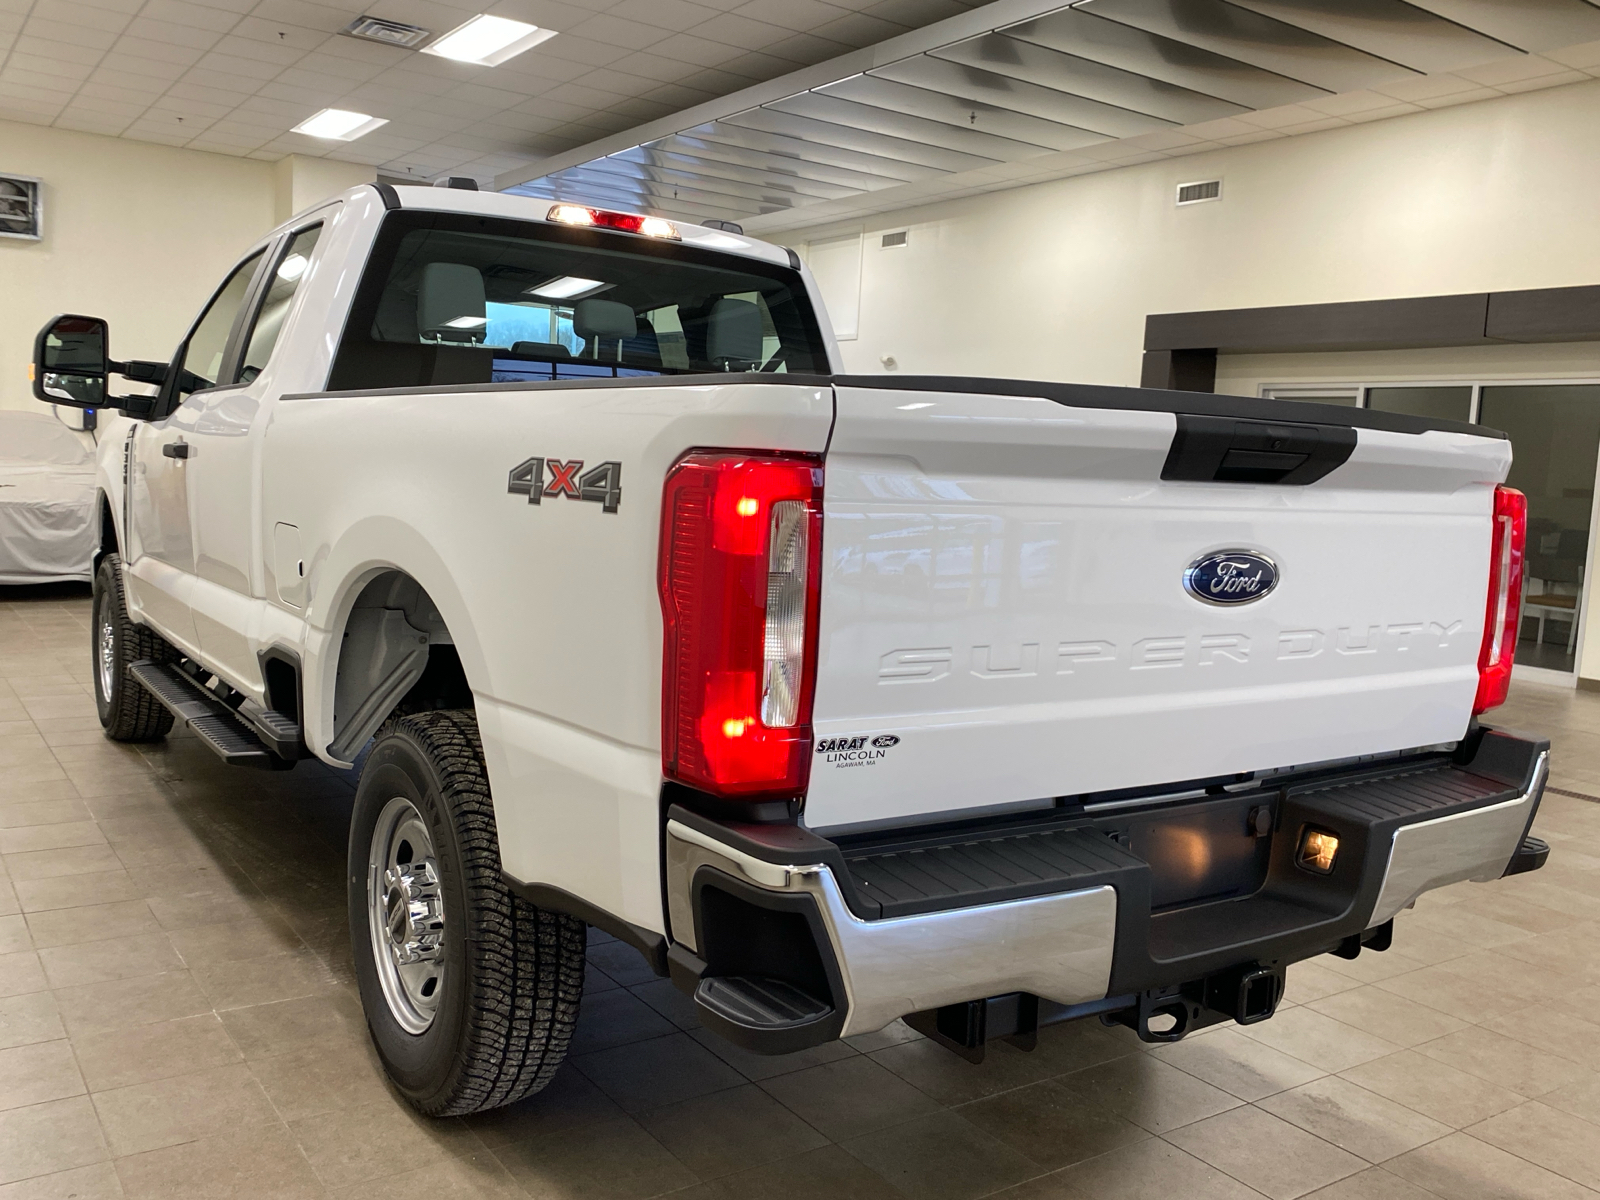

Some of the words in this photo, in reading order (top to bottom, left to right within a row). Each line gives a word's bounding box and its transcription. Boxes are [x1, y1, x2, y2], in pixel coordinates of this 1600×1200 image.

[1210, 561, 1263, 594] Ford
[877, 632, 1251, 686] SUPER
[1276, 619, 1463, 661] DUTY
[815, 735, 869, 753] SARAT
[826, 749, 886, 763] LINCOLN
[835, 761, 865, 769] AGAWAM,
